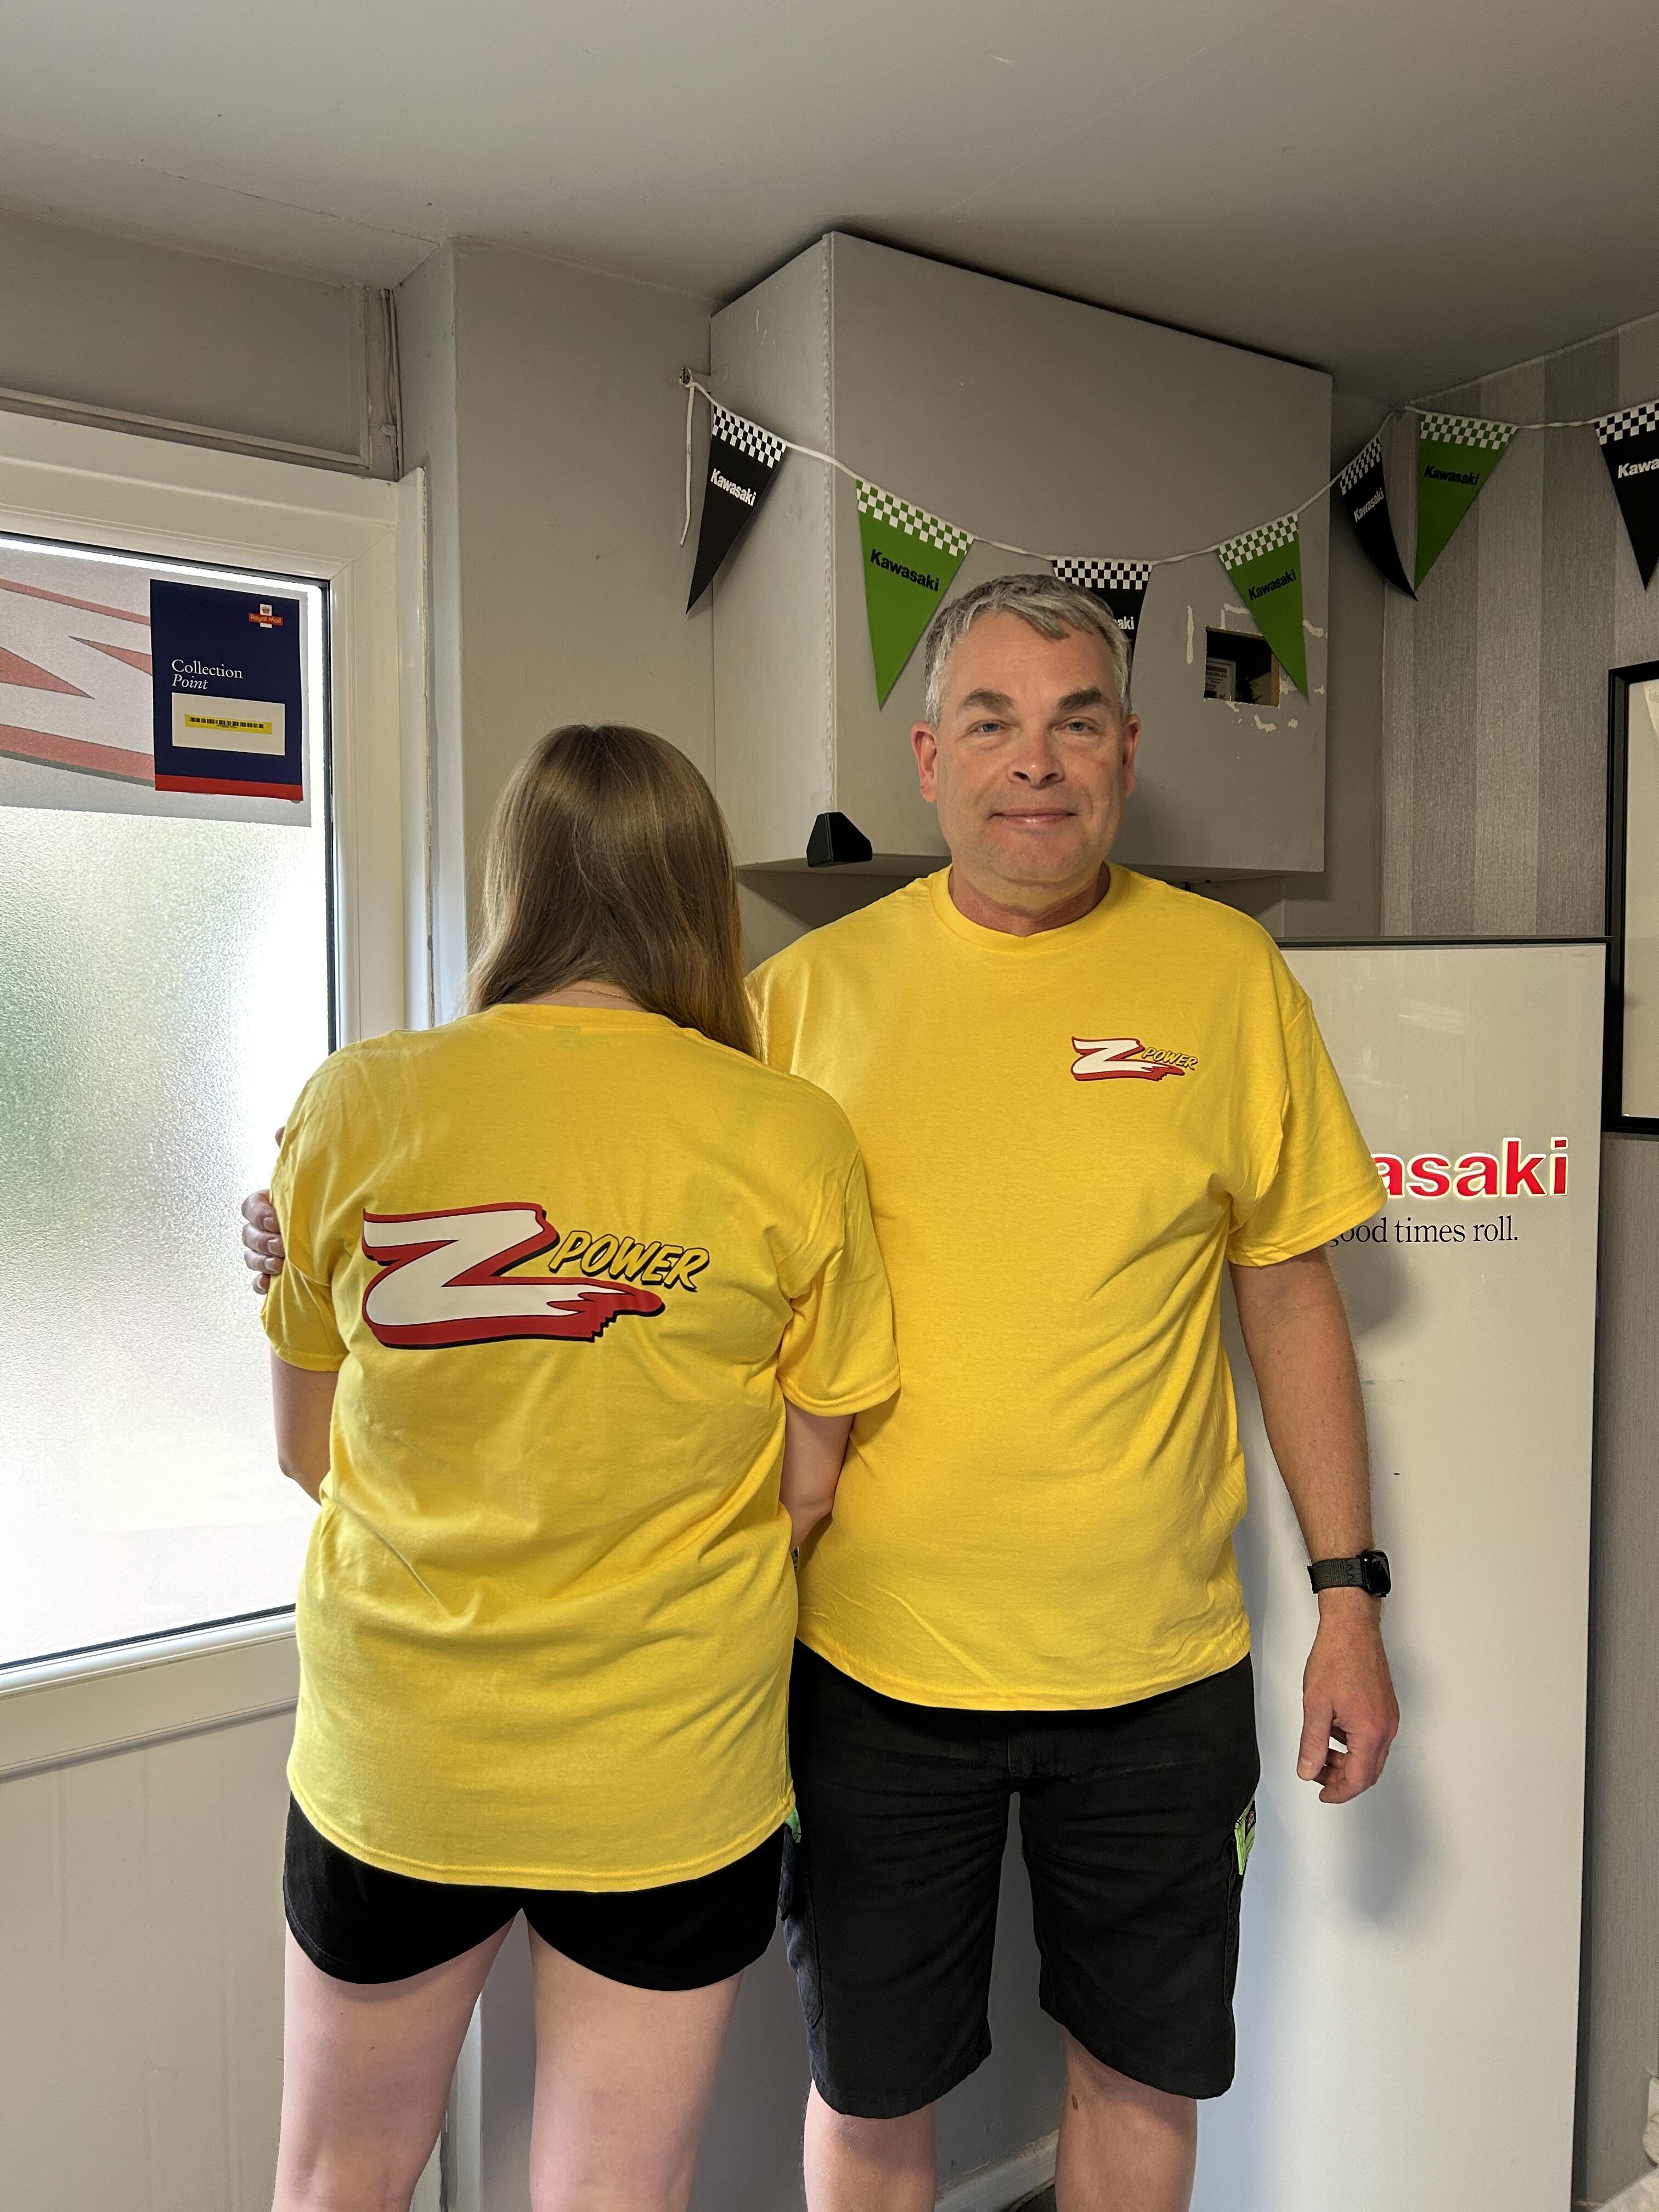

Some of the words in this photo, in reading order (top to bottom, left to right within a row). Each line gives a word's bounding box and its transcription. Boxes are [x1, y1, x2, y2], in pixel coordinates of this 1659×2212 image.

[710, 468, 757, 507] Kawasaki
[1424, 465, 1480, 486] Kawasaki
[1353, 487, 1385, 523] Kawasaki
[870, 549, 940, 592] Kawasaki
[1248, 568, 1297, 601] Kawasaki
[250, 614, 268, 622] Royal
[171, 659, 243, 679] Collection
[171, 674, 208, 690] Point
[1070, 1036, 1186, 1081] Z
[1141, 1047, 1199, 1071] POWER
[1325, 1217, 1388, 1247] ood
[1395, 1217, 1466, 1243] times
[1472, 1215, 1519, 1243] roll.
[362, 1201, 666, 1350] Z
[549, 1229, 710, 1292] POWER
